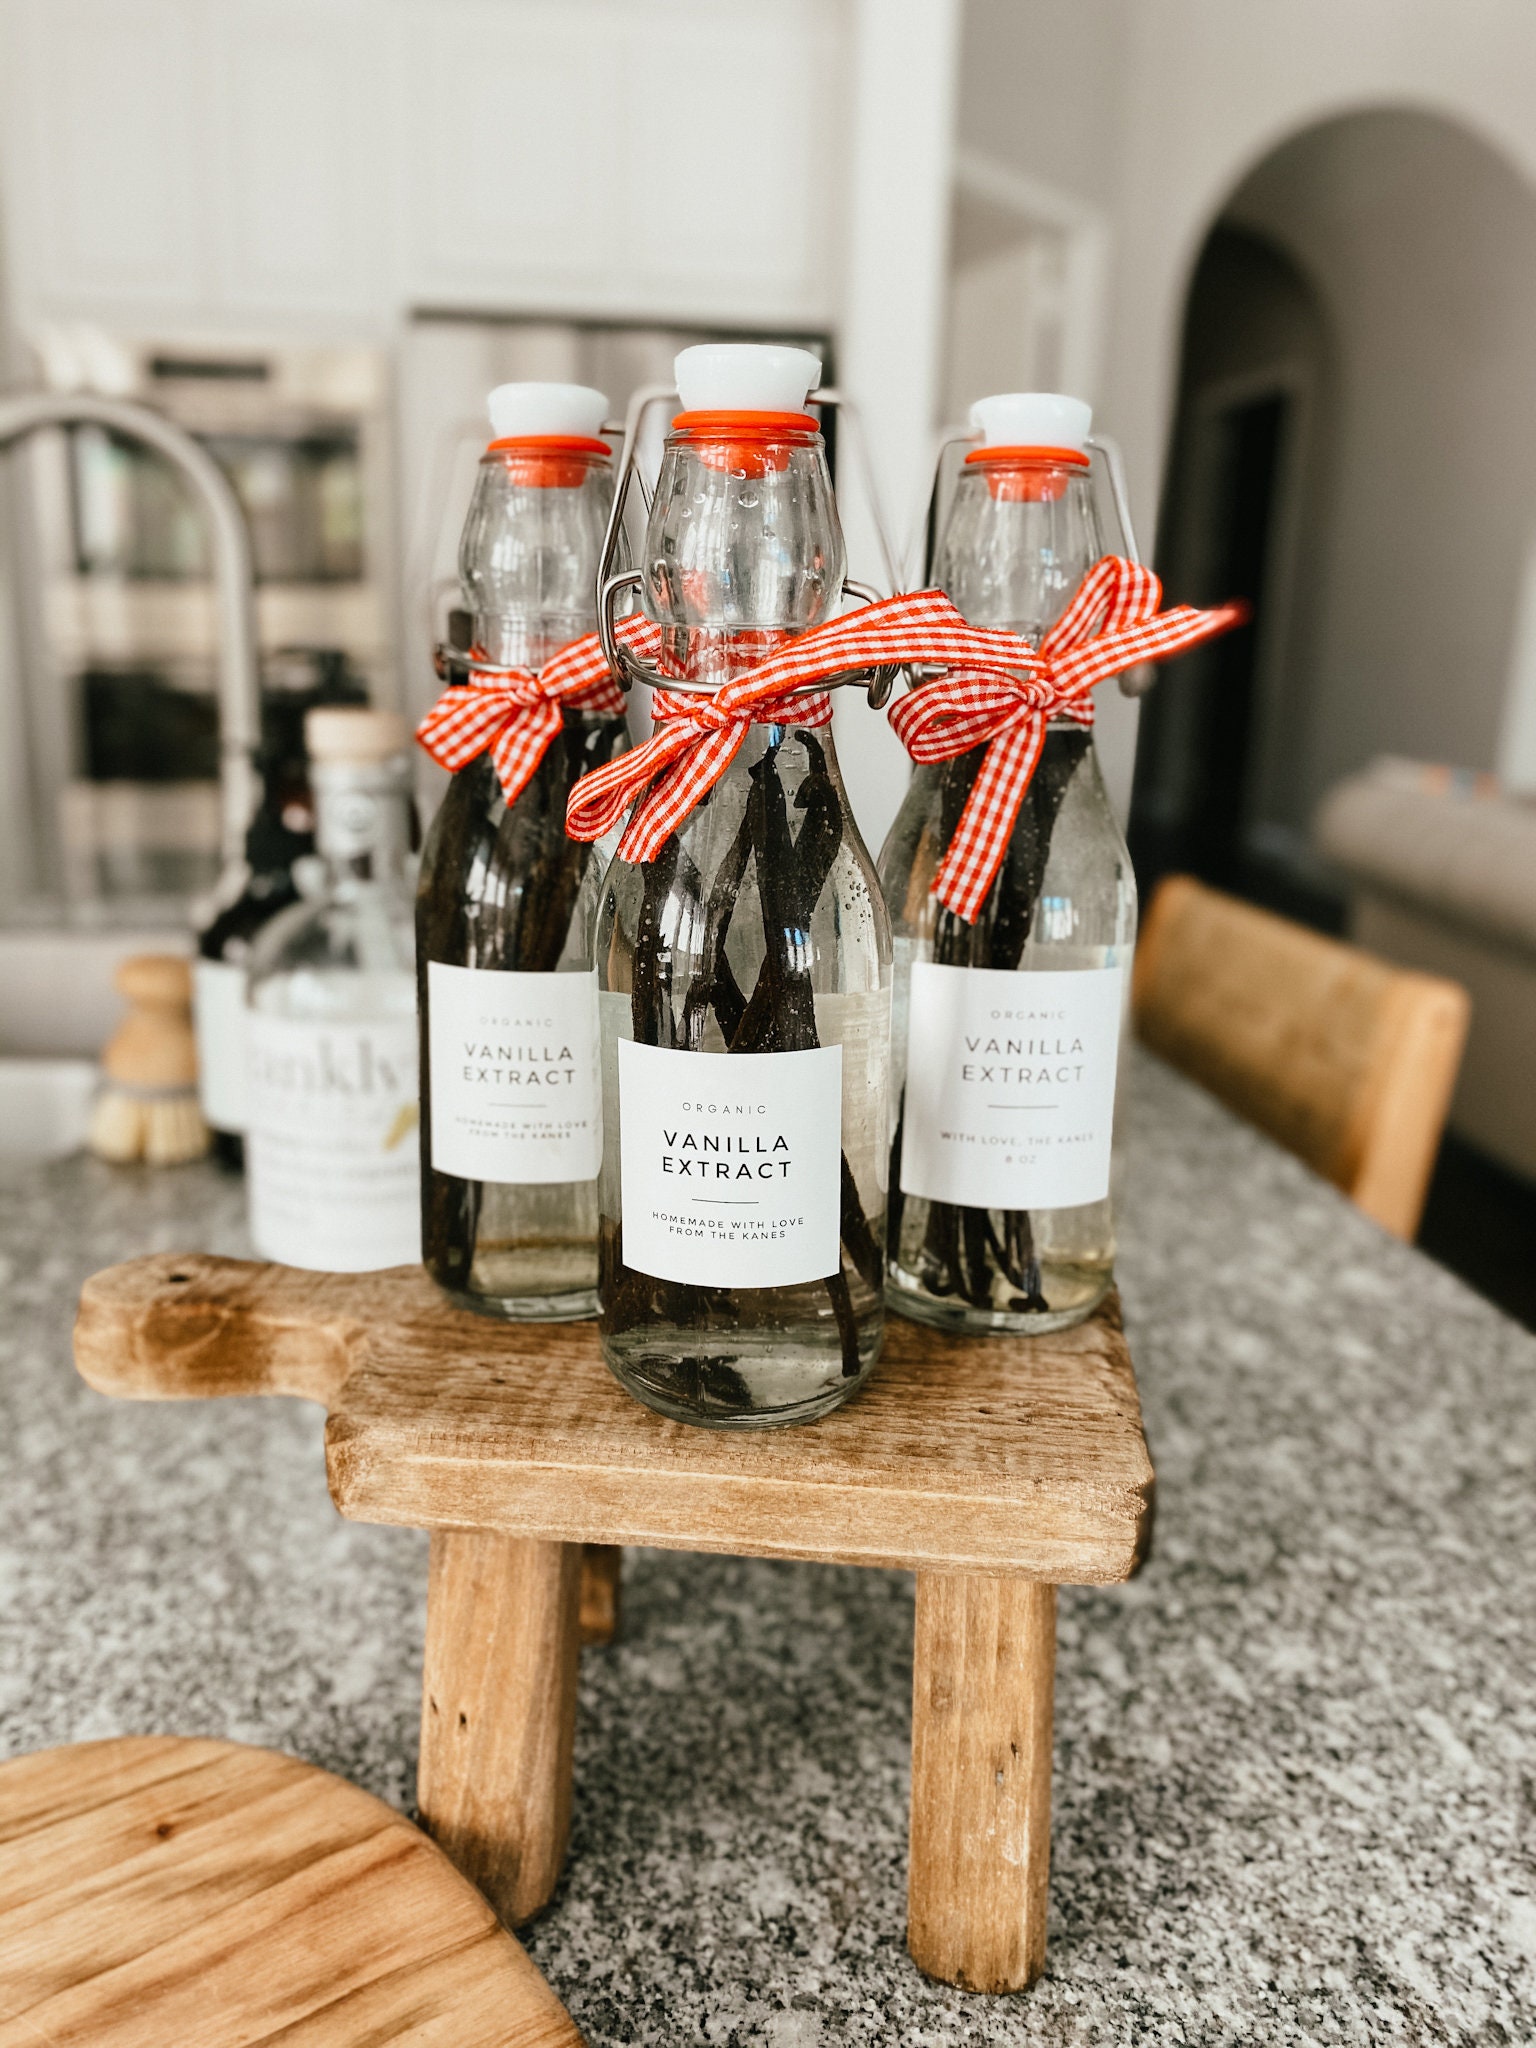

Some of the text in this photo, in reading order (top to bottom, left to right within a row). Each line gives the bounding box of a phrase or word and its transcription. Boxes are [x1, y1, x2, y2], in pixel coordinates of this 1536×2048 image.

[990, 1010, 1066, 1020] ORGANIC
[464, 1043, 574, 1062] VANILLA
[965, 1036, 1084, 1055] VANILLA
[463, 1066, 576, 1085] EXTRACT
[962, 1065, 1084, 1083] EXTRACT
[682, 1102, 766, 1114] ORGANIC
[663, 1130, 789, 1153] VANILLA
[940, 1130, 975, 1142] WITH
[662, 1156, 792, 1180] EXTRACT
[652, 1211, 804, 1230] HOMEMADE WITH LOVE
[669, 1226, 786, 1240] FROM THE KANES
